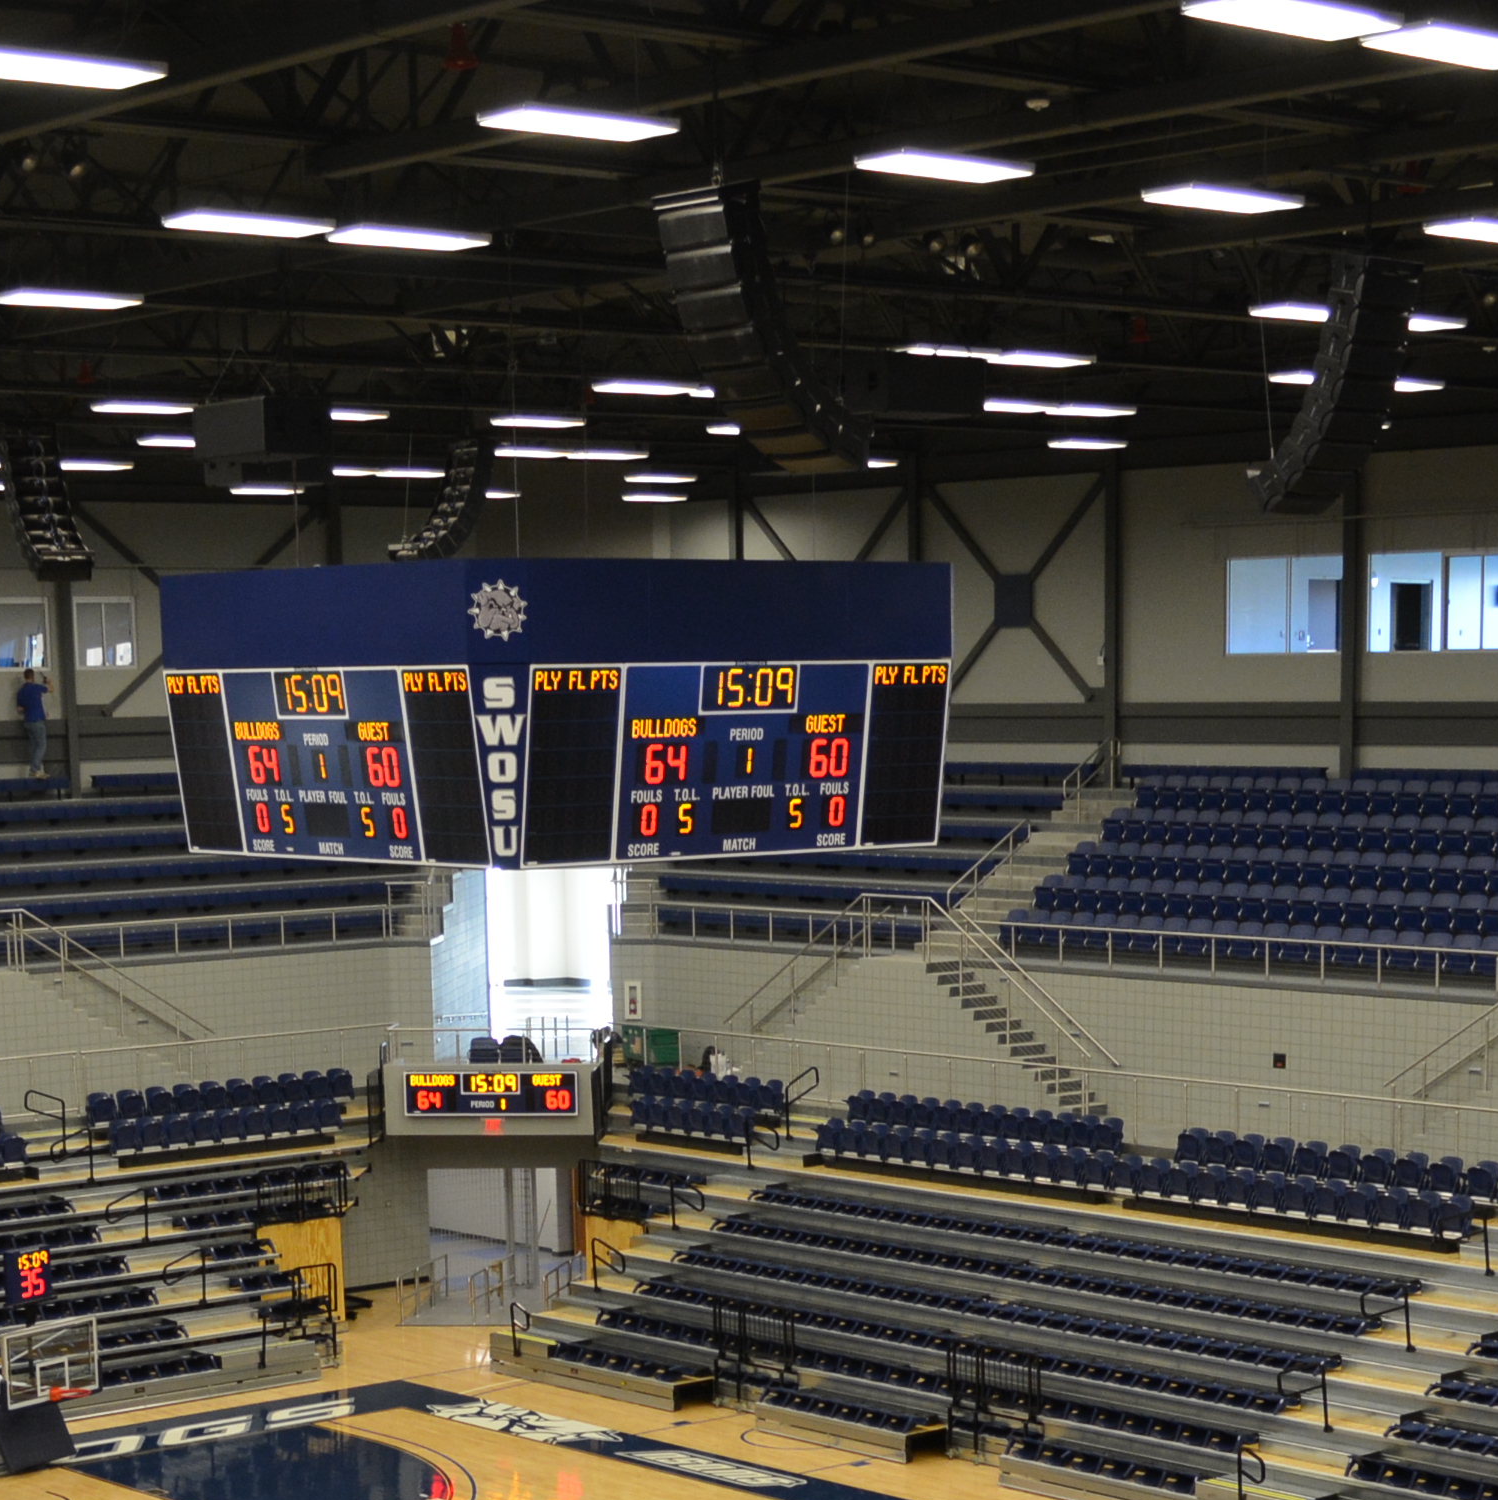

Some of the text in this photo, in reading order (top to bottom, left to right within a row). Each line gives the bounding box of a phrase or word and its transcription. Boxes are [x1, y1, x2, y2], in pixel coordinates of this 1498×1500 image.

[166, 675, 220, 694] PLY FL PTS
[403, 672, 467, 692] PLY FL PTS
[534, 670, 619, 691] PLY FL PTS
[874, 664, 946, 686] PLY FL PTS
[284, 674, 344, 713] 15:09
[717, 667, 794, 708] 15:09
[234, 721, 280, 741] BULLDOGS
[358, 721, 390, 742] GUEST
[632, 717, 697, 738] BULLDOGS
[806, 714, 846, 734] GUEST
[303, 733, 329, 747] PERIOD
[729, 728, 764, 742] PERIOD
[247, 745, 280, 785] 64
[318, 753, 327, 779] 1
[365, 746, 400, 788] 60
[475, 676, 526, 857] SWOSU
[645, 743, 689, 784] 64
[745, 747, 753, 774] 1
[809, 738, 849, 779] 60
[246, 788, 268, 802] FOULS
[274, 789, 294, 803] T.O.L.
[299, 789, 348, 805] PLAYER FOUL
[353, 791, 375, 805] T.O.L.
[381, 791, 406, 807] FOULS
[631, 789, 663, 804] FOULS
[674, 788, 701, 802] T.O.L.
[712, 784, 775, 801] PLAYER FOUL
[785, 783, 810, 798] T.O.L.
[820, 782, 849, 796] FOULS
[255, 802, 270, 833] 0
[280, 804, 295, 834] 5
[361, 806, 375, 838] 5
[640, 804, 657, 837] 0
[679, 803, 692, 835] 5
[789, 798, 803, 829] 5
[828, 796, 844, 828] 0
[391, 806, 408, 839] 0
[253, 838, 275, 852] SCORE
[318, 841, 344, 856] MATCH
[627, 843, 660, 857] SCORE
[723, 838, 756, 852] MATCH
[816, 833, 846, 848] SCORE
[389, 844, 414, 859] SCORE
[409, 1074, 455, 1087] BULLDOGS
[470, 1074, 517, 1093] 15:09
[532, 1074, 562, 1087] GUEST
[417, 1090, 442, 1110] 64
[470, 1100, 495, 1109] PERIOD
[545, 1090, 571, 1110] 60
[18, 1250, 49, 1270] 15:09
[20, 1268, 45, 1299] 35
